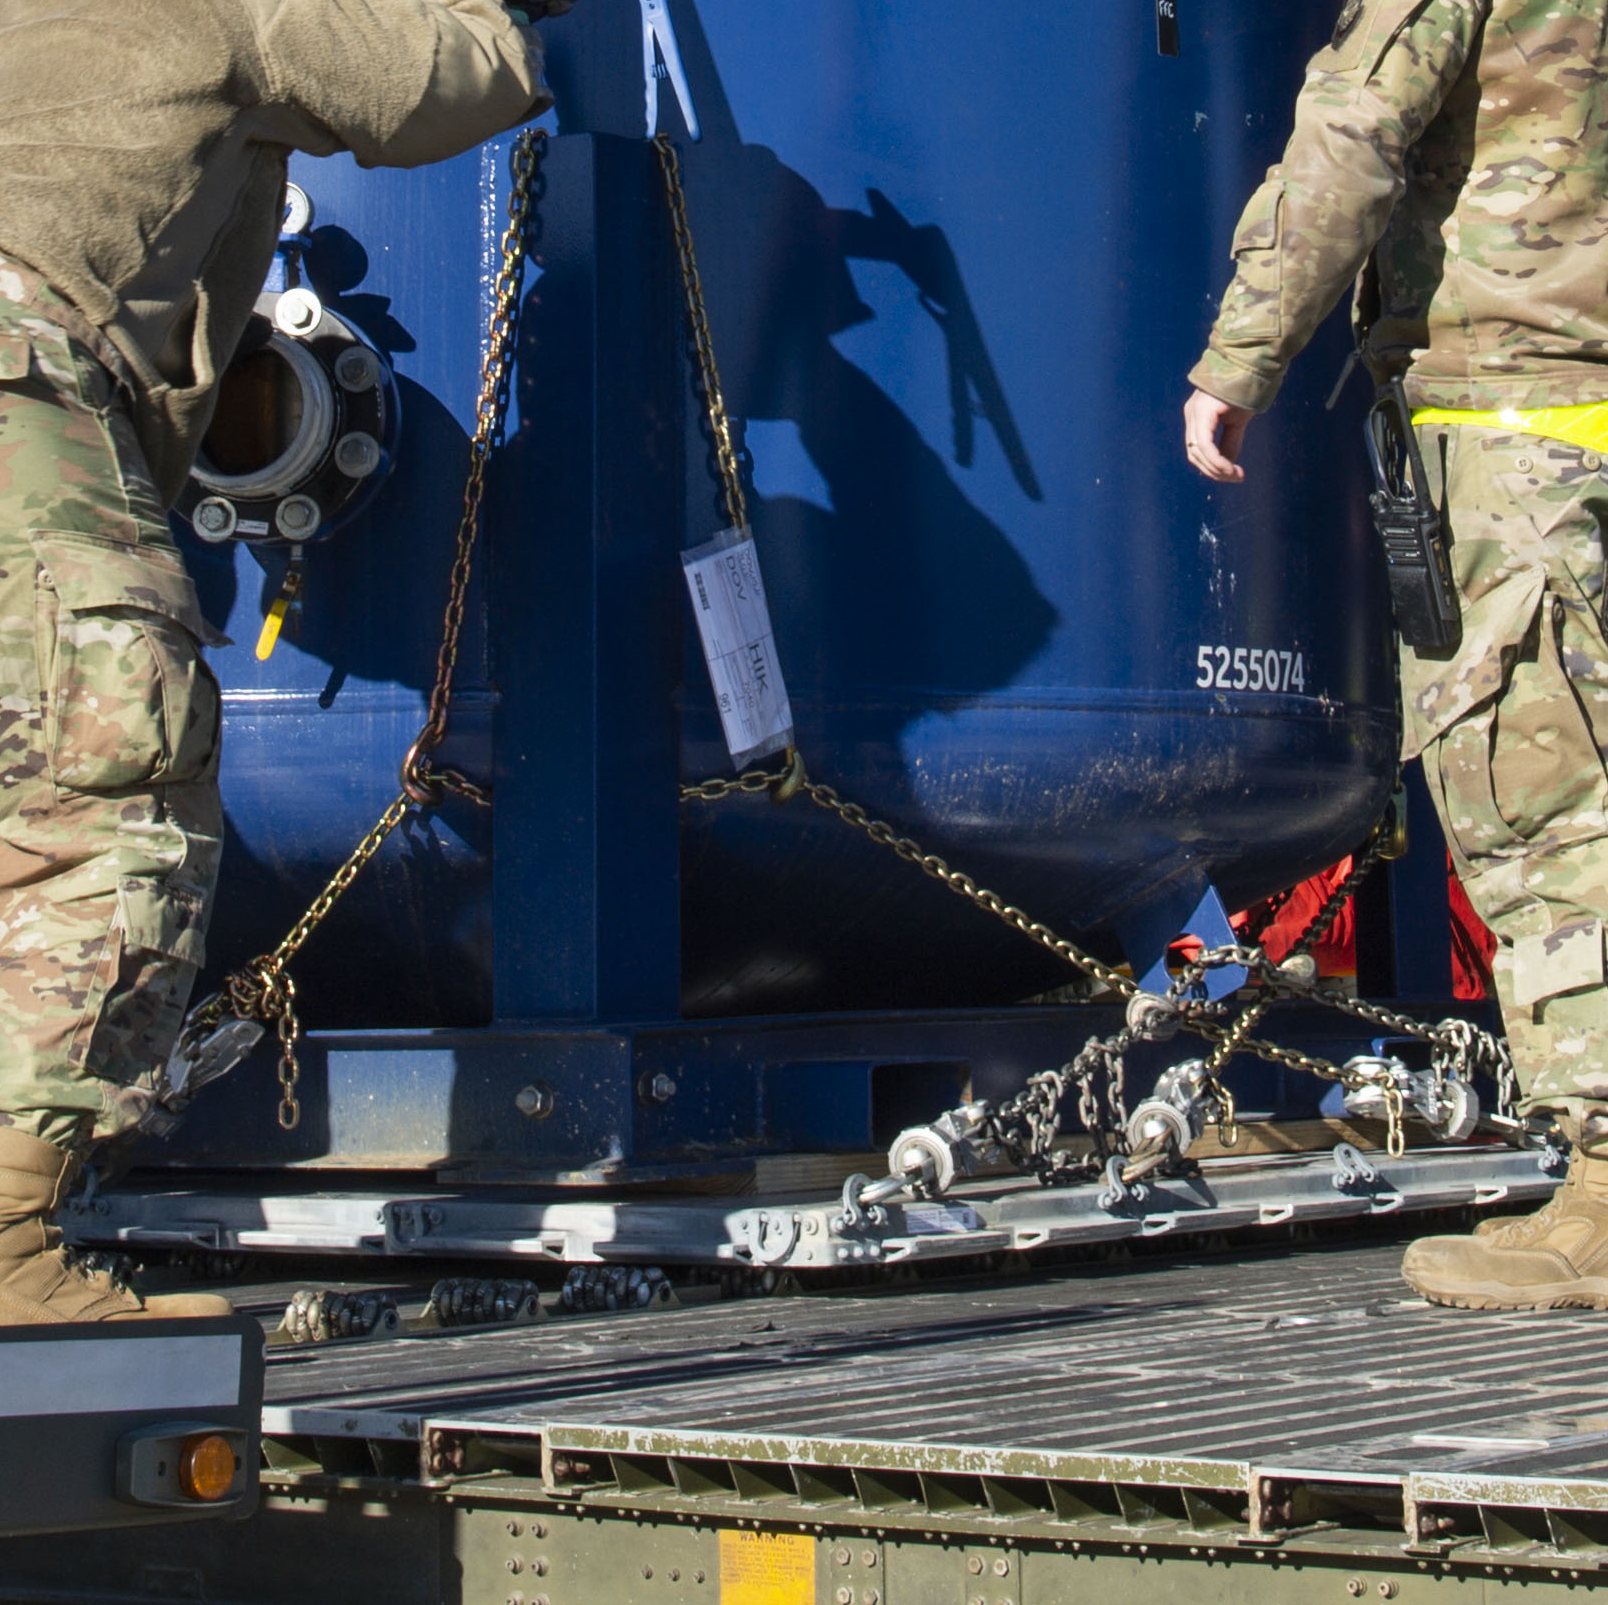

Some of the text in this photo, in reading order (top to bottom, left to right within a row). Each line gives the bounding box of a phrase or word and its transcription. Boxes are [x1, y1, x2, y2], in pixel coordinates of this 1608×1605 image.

[726, 555, 747, 601] DOV
[749, 643, 769, 695] HIK
[1196, 645, 1305, 693] 5255074
